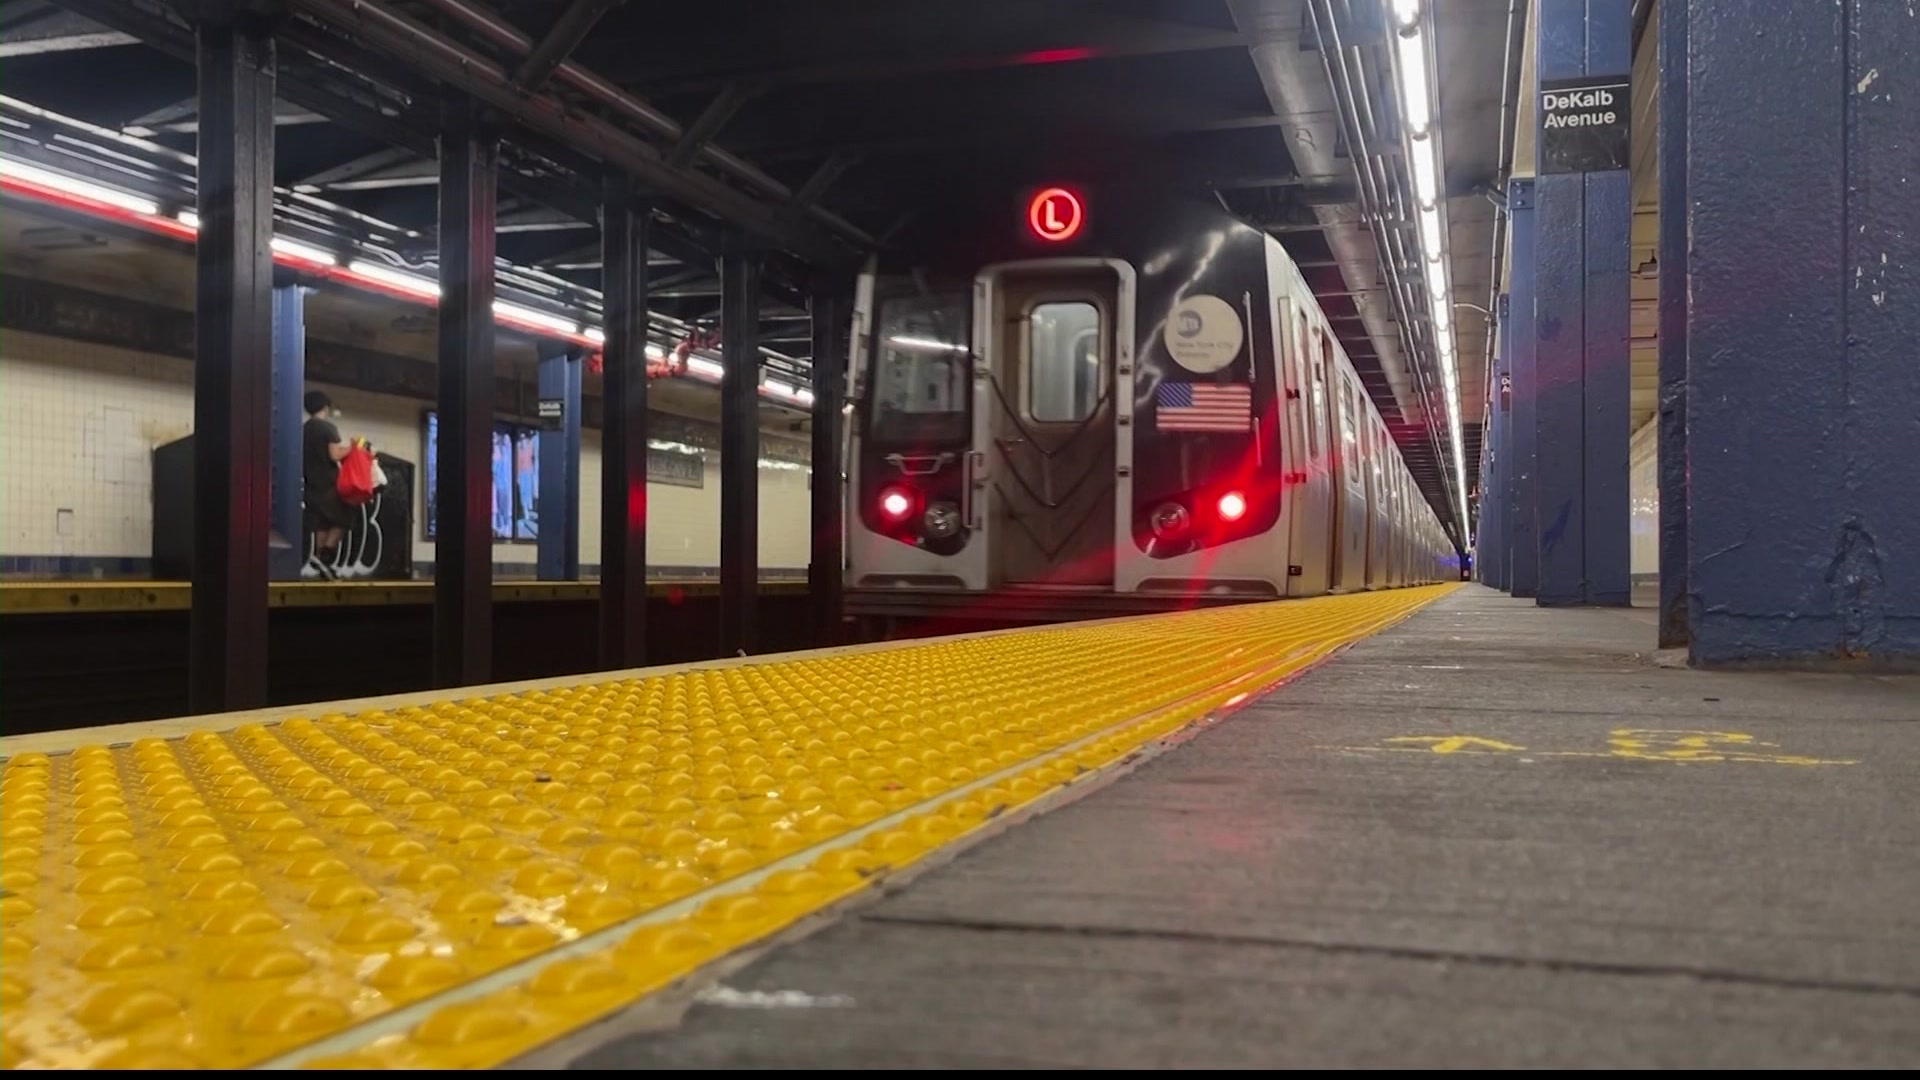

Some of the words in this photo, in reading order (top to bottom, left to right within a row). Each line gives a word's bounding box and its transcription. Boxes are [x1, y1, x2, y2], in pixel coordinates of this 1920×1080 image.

[1543, 90, 1614, 110] DeKalb
[1543, 111, 1616, 129] Avenue
[1045, 199, 1066, 231] L
